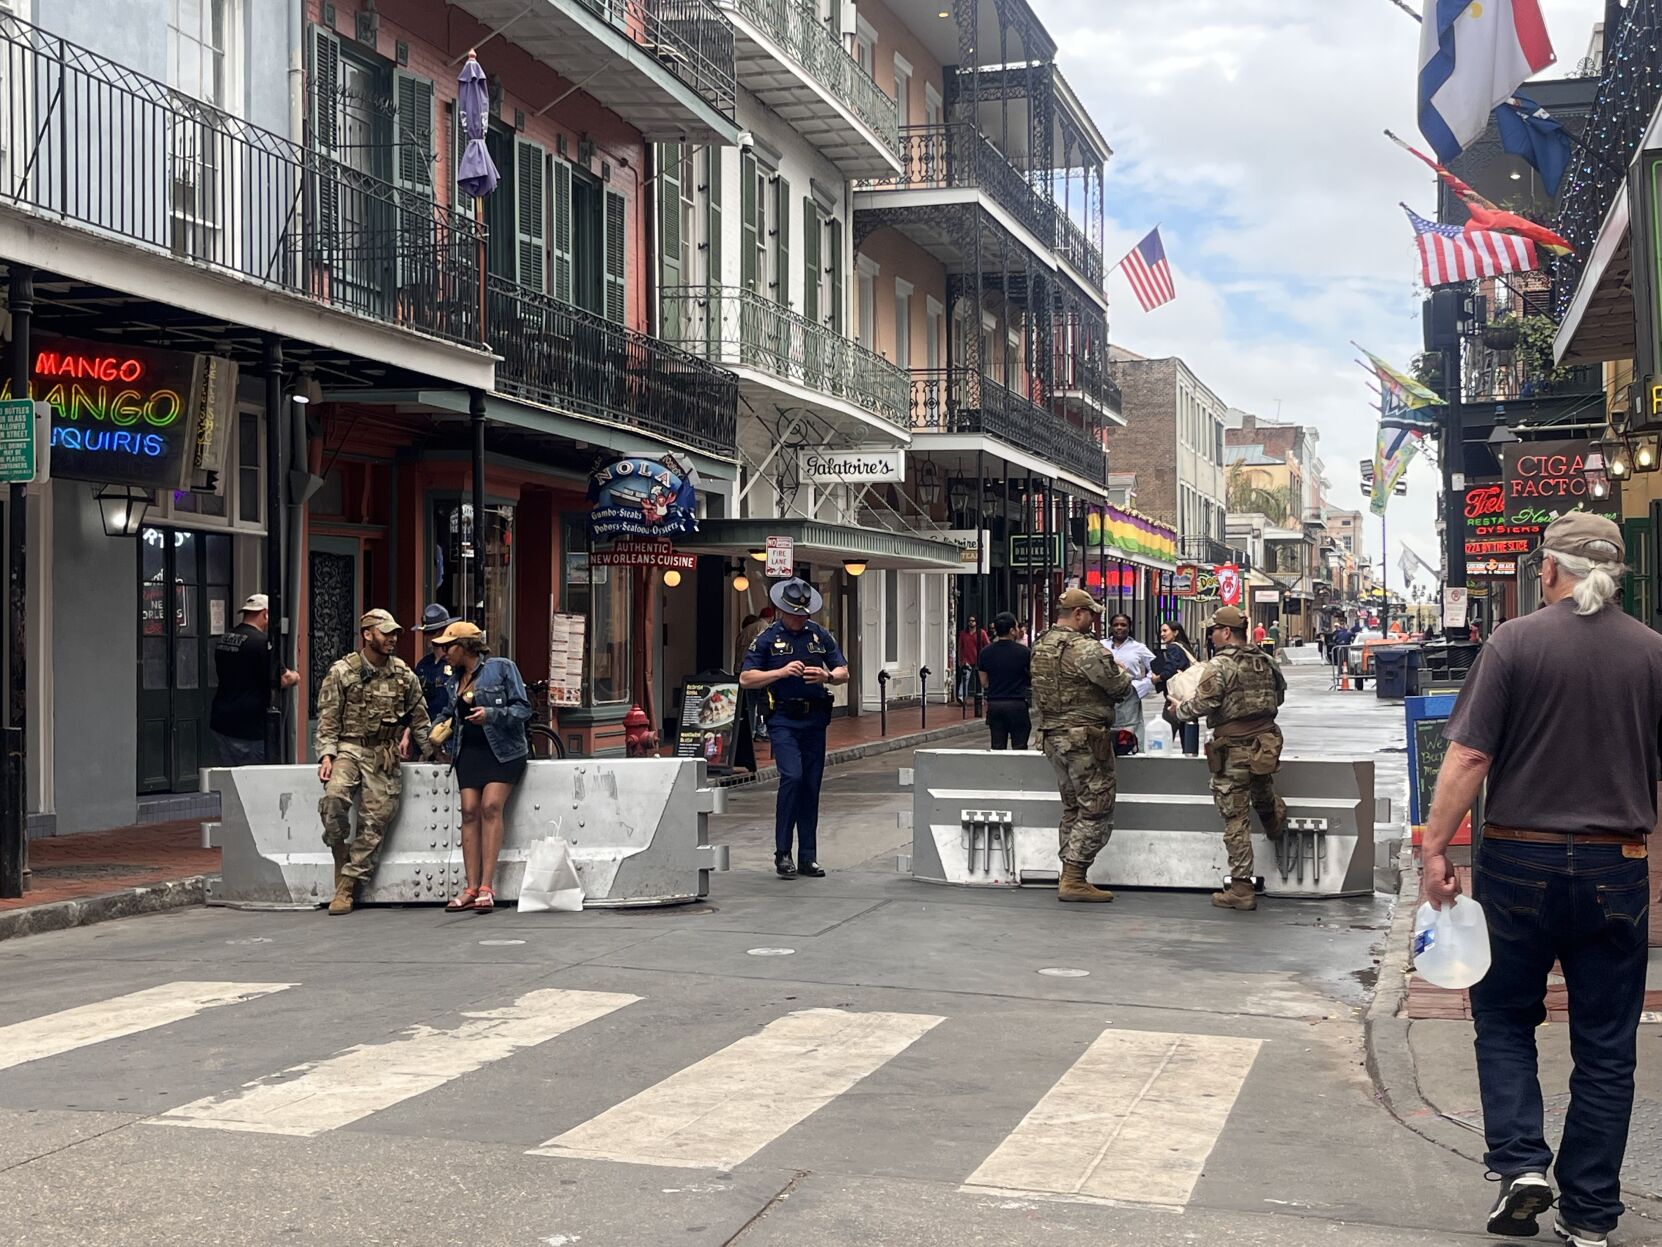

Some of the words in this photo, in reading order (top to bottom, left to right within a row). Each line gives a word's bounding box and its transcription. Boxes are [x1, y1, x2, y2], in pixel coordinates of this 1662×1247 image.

[35, 352, 141, 382] MANGO
[594, 460, 671, 488] NOLA
[806, 455, 894, 477] Galatoire's
[1517, 454, 1586, 477] CIGA
[616, 541, 669, 553] AUTHENTIC
[590, 554, 611, 565] NEW
[612, 553, 656, 565] ORLEANS
[657, 554, 694, 567] CUISINE
